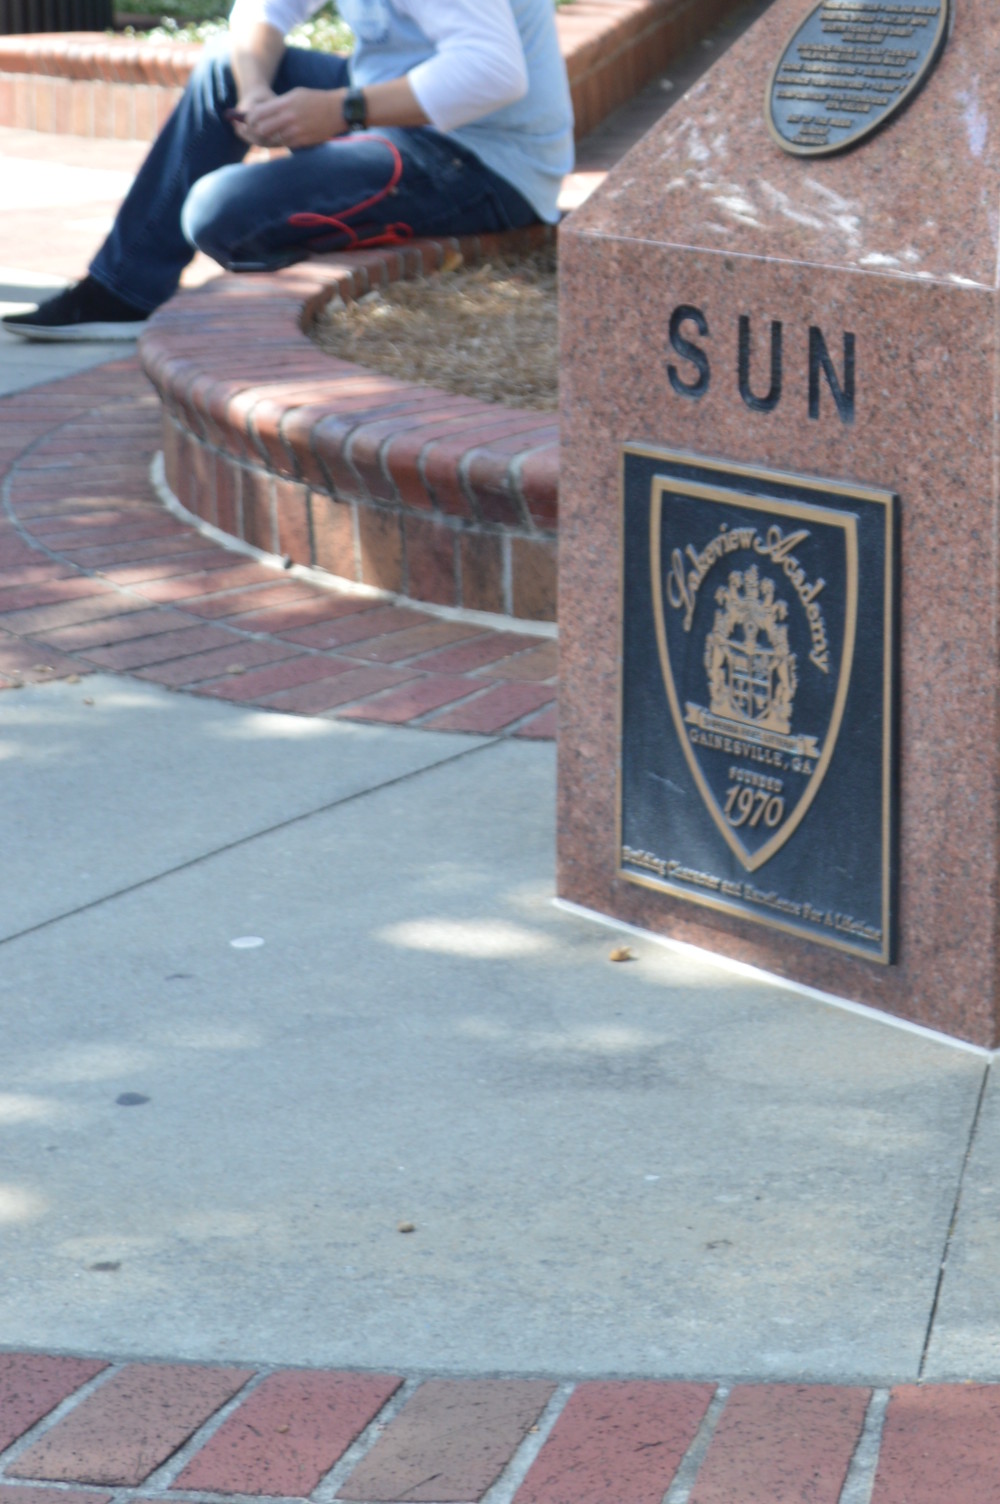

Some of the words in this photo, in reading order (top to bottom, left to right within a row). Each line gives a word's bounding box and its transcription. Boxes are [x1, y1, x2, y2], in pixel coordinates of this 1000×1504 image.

[667, 304, 857, 425] SUN
[666, 522, 758, 632] Lakeview
[753, 524, 830, 674] Academy
[724, 783, 785, 827] 1970
[728, 765, 784, 793] FOUNDED
